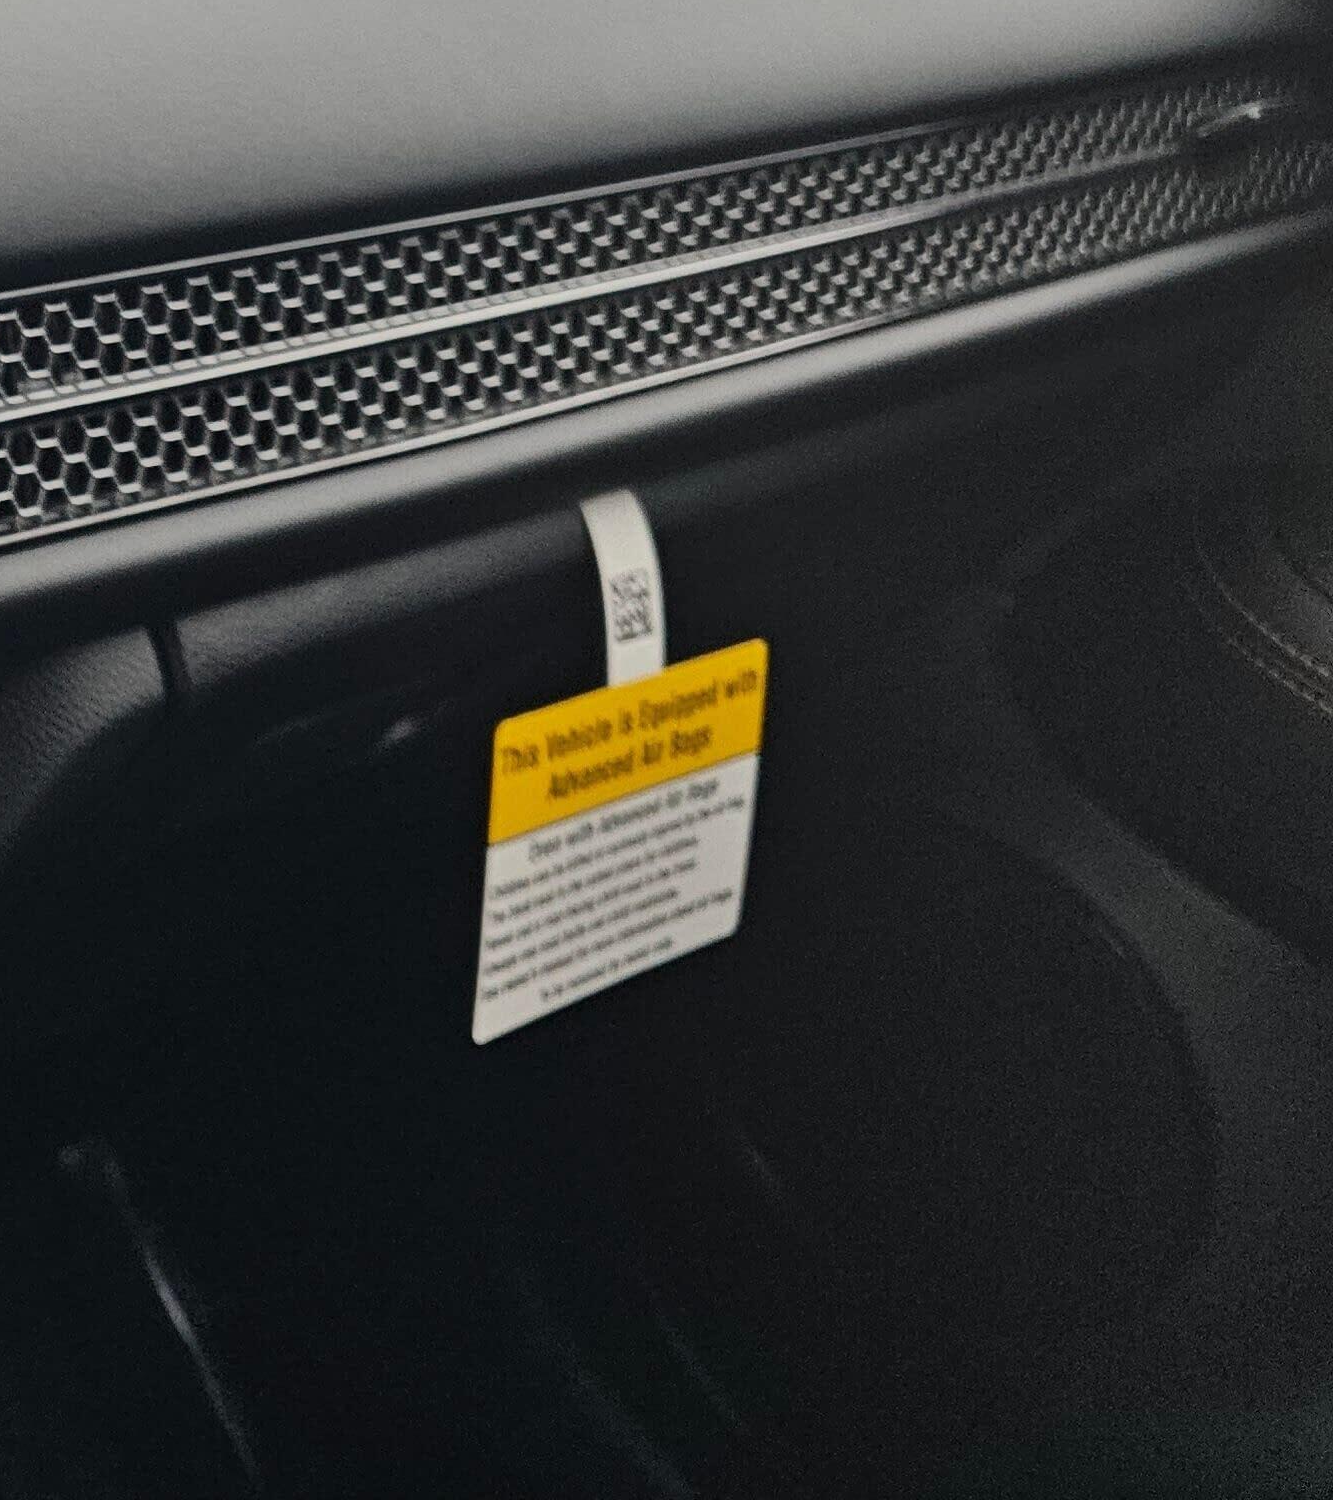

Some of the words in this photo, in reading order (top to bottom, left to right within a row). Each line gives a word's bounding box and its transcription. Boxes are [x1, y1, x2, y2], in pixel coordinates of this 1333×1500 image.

[502, 744, 539, 773] This
[546, 717, 613, 760] Vehicle
[638, 680, 719, 731] Equipped
[723, 668, 757, 698] with
[548, 749, 635, 799] Advanced
[642, 740, 665, 765] Air
[670, 724, 714, 758] Bags
